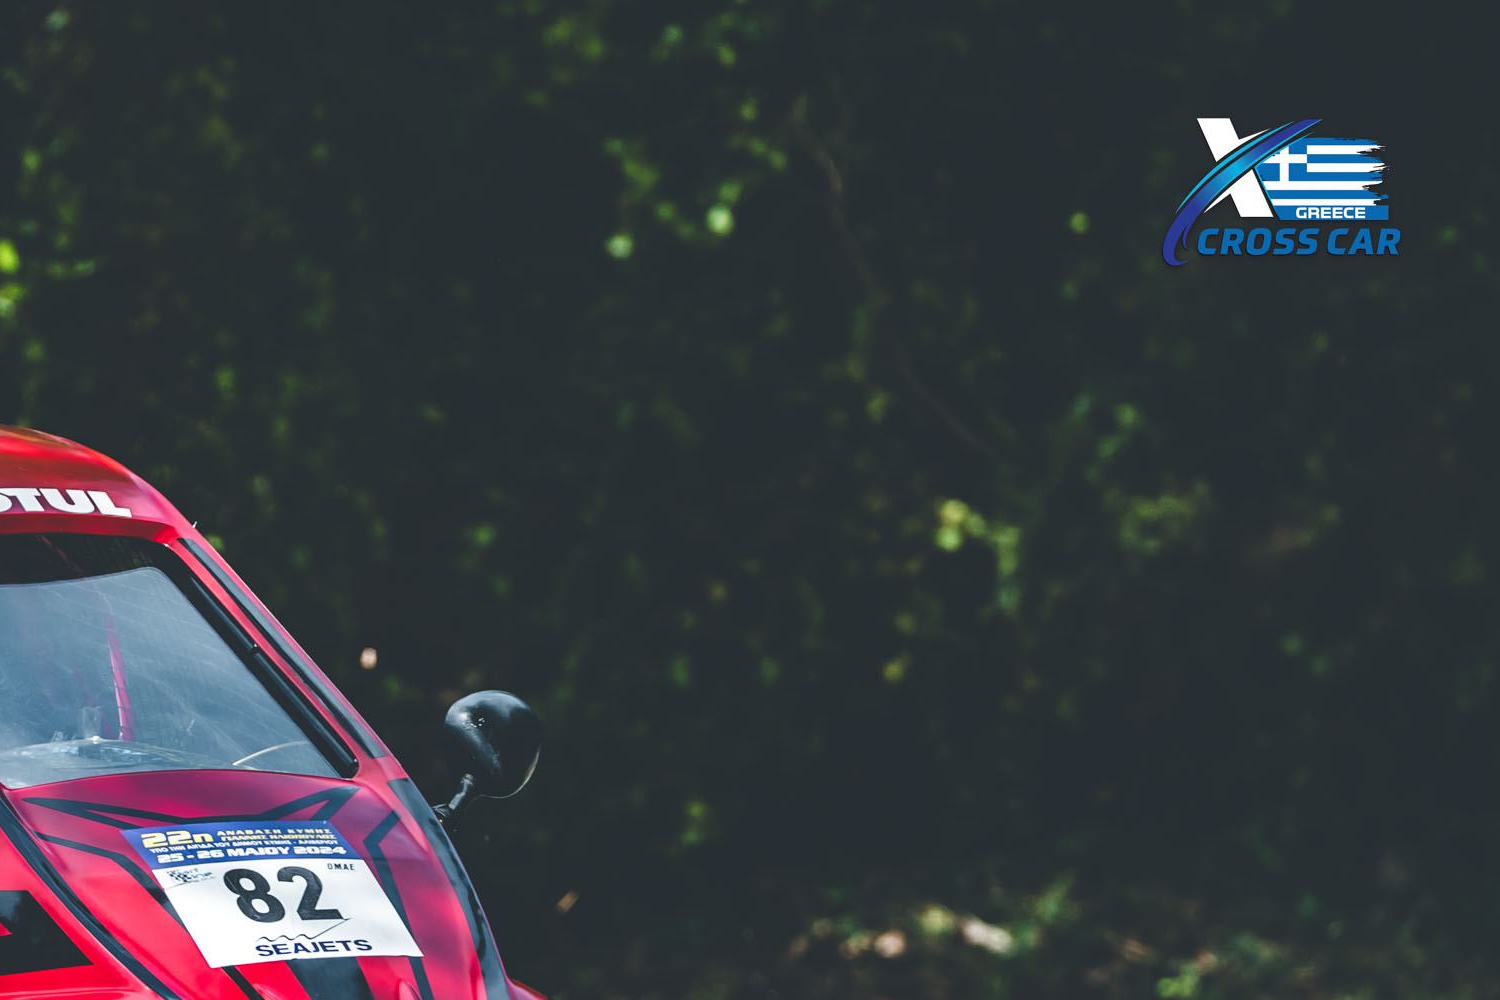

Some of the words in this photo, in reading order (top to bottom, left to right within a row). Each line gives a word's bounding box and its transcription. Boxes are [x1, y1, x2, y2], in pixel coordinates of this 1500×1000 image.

[157, 852, 185, 864] 25
[196, 849, 225, 859] 26
[293, 846, 347, 855] 2024
[222, 866, 344, 924] 82
[255, 938, 373, 957] SEAJETS
